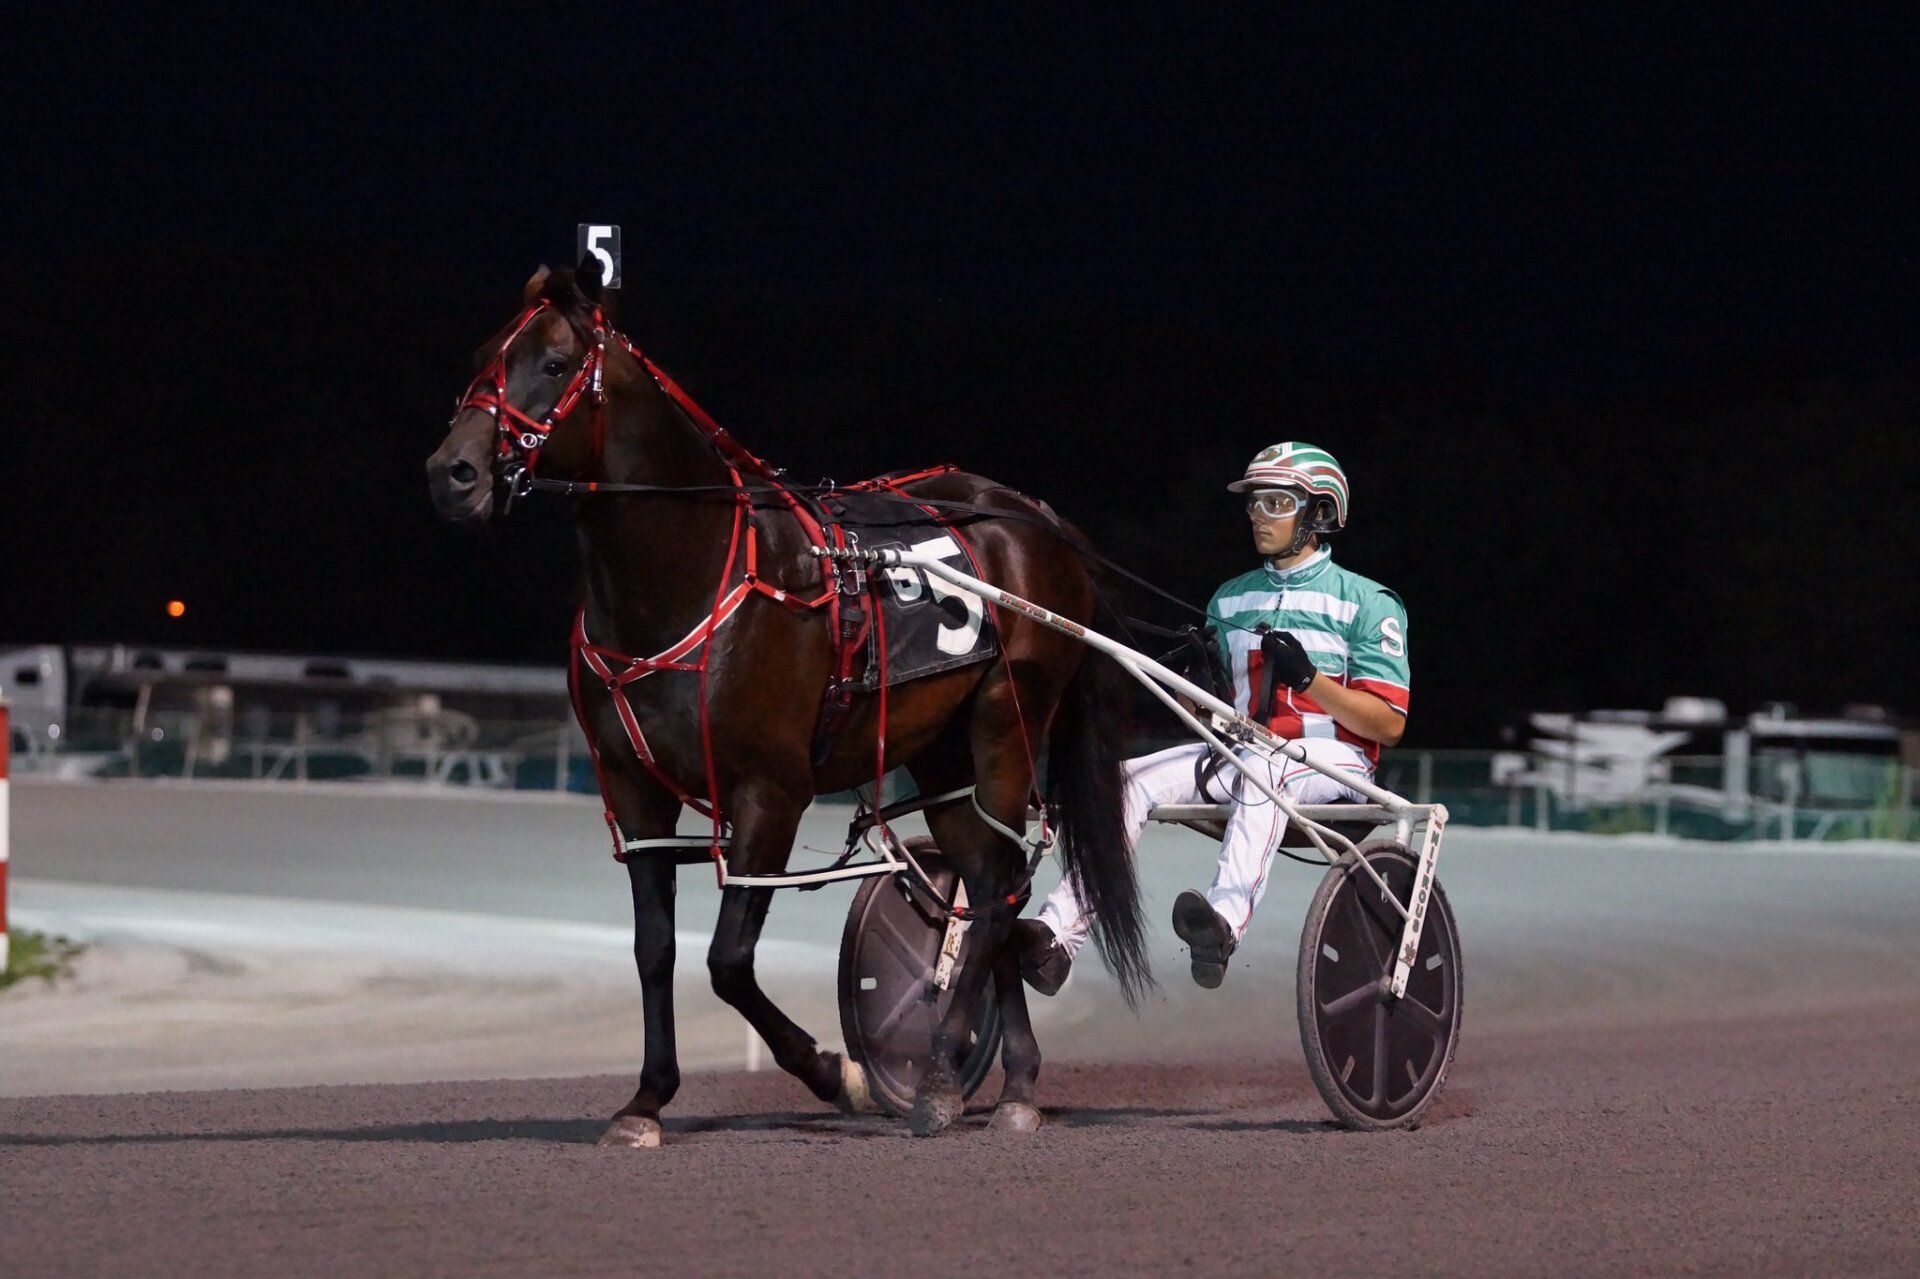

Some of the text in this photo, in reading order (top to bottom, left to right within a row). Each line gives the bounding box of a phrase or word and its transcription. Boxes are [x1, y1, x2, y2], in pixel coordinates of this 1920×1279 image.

[587, 225, 613, 286] 5
[910, 536, 983, 655] 5
[1380, 616, 1404, 657] S
[1412, 830, 1440, 933] NITROUS
